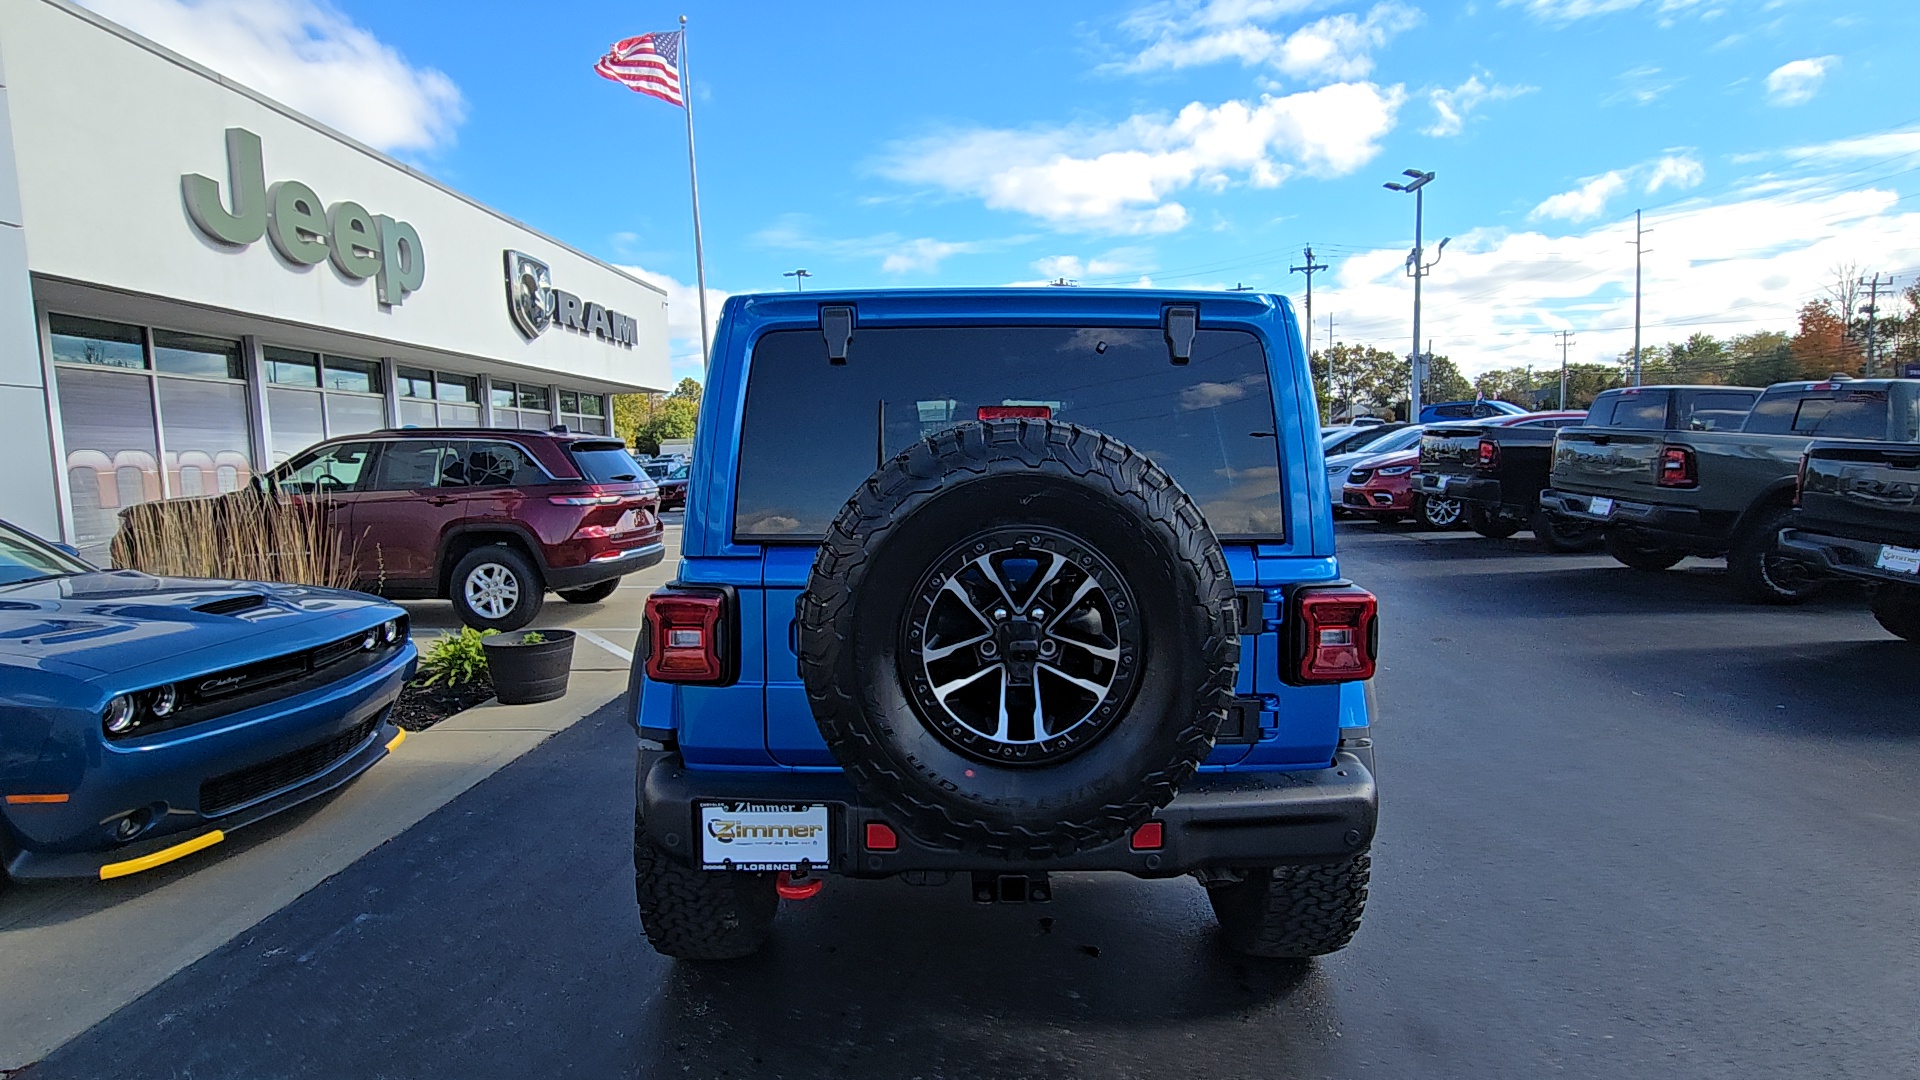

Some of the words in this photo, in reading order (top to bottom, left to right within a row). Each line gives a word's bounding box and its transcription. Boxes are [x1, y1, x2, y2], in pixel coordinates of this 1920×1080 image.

[181, 127, 425, 306] Jeep
[552, 288, 639, 347] RAM
[1848, 478, 1920, 499] RA
[735, 802, 796, 812] Zimmer
[714, 820, 824, 839] Zimmer
[736, 863, 798, 871] FLORENCE
